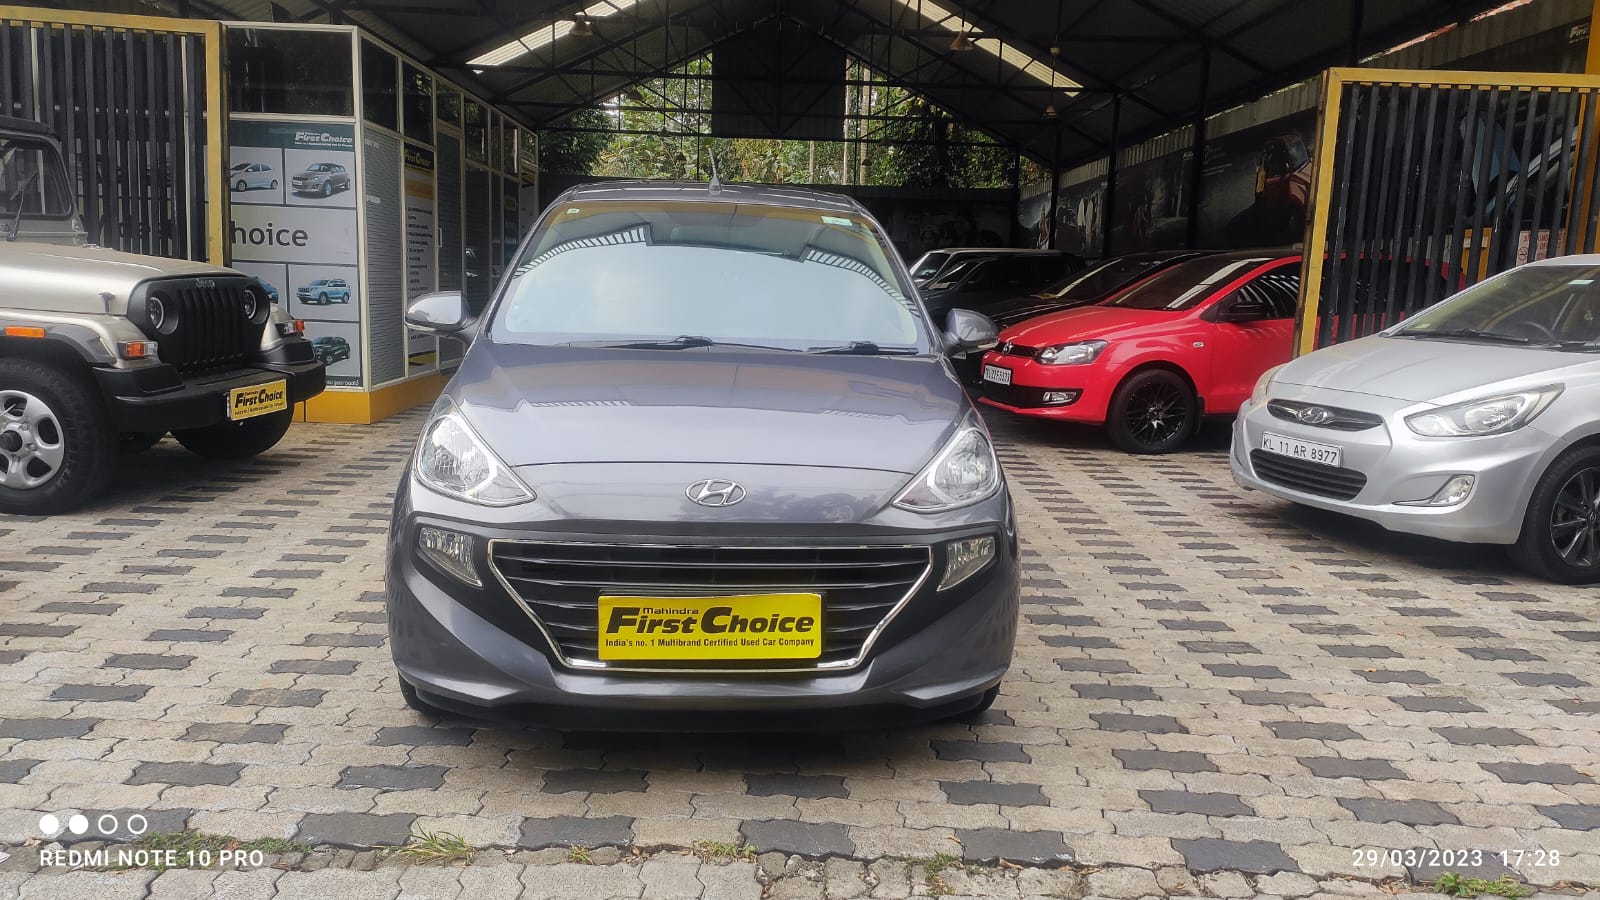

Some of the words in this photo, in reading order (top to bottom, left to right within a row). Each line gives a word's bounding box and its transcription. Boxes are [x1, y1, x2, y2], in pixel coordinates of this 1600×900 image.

[231, 221, 309, 247] hoice
[194, 278, 216, 289] Jeep
[235, 392, 258, 408] First
[257, 388, 284, 404] Choice
[1263, 438, 1275, 450] KL
[1280, 441, 1289, 454] 11
[1293, 444, 1307, 458] AR
[1311, 448, 1337, 463] 8977
[605, 606, 698, 634] First
[700, 606, 815, 634] Choice
[642, 607, 699, 615] Mahindra
[605, 638, 634, 647] India's
[635, 639, 648, 647] no.
[651, 638, 655, 647] 1
[658, 638, 701, 647] Multibrand
[703, 638, 738, 647] Certified
[741, 638, 760, 646] Used
[762, 638, 777, 646] Car
[778, 637, 815, 648] Company
